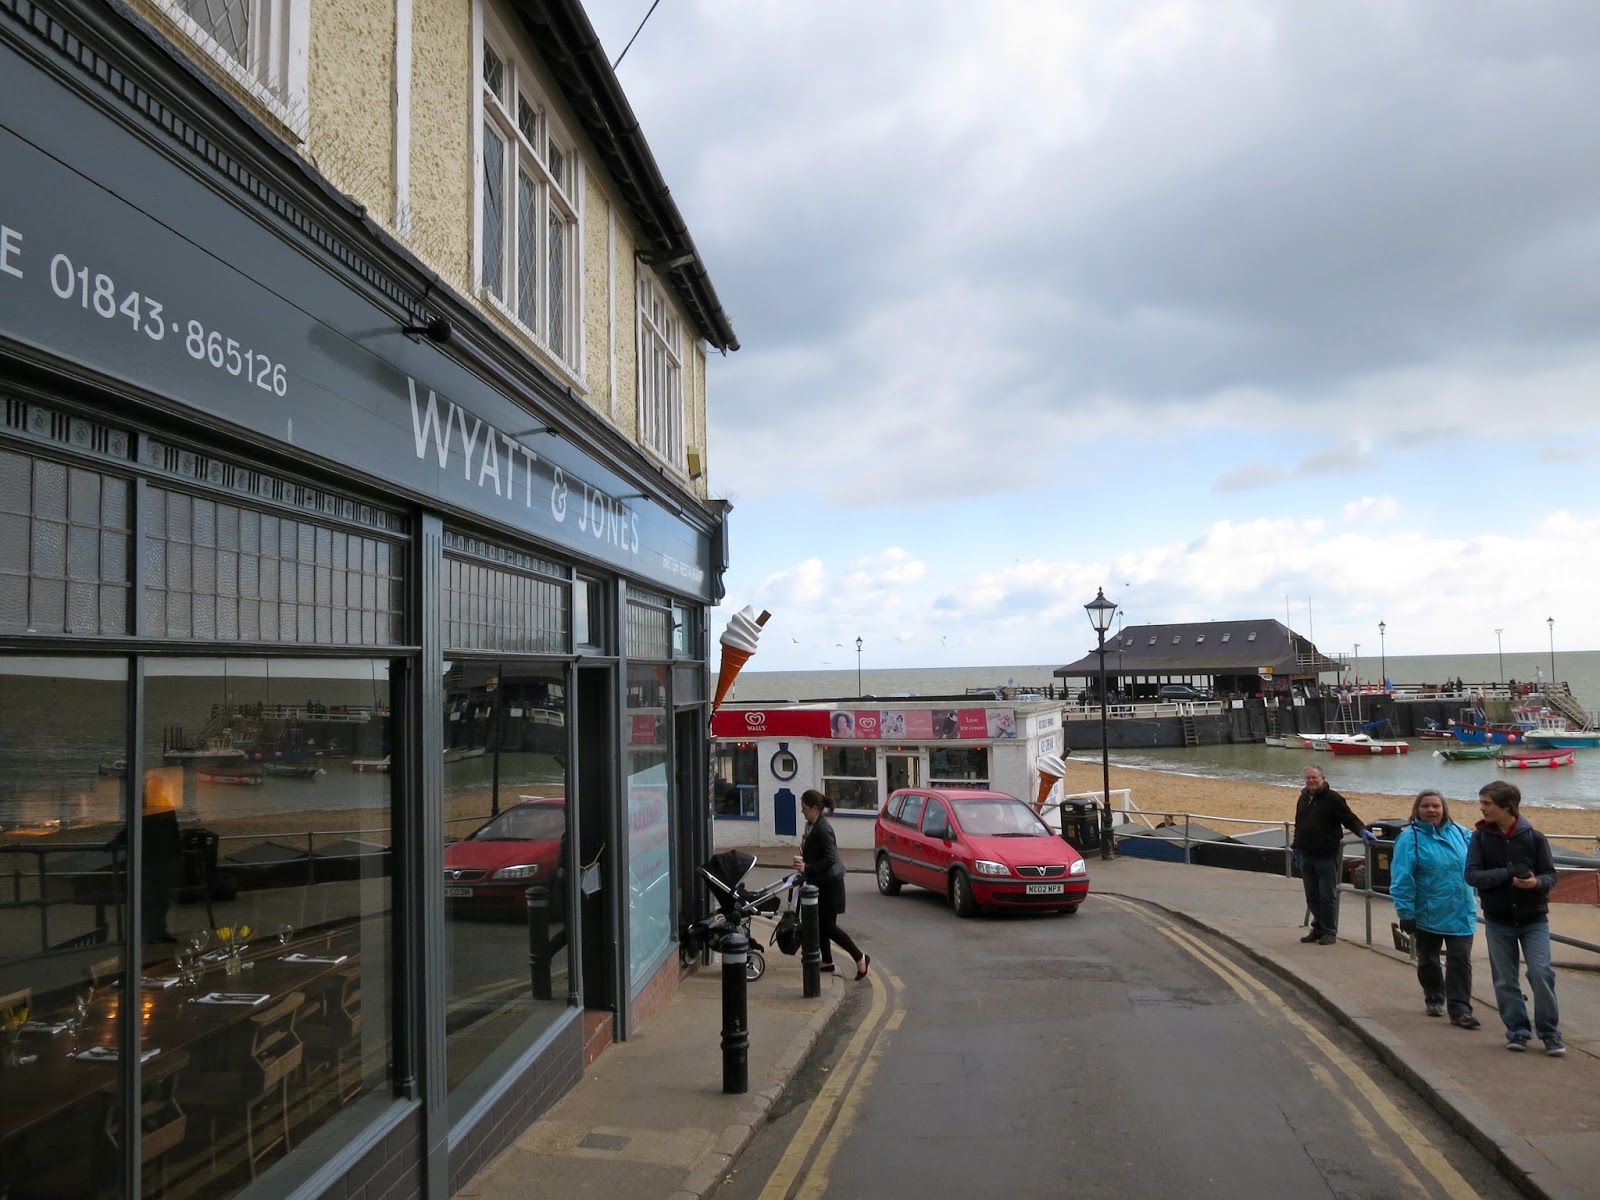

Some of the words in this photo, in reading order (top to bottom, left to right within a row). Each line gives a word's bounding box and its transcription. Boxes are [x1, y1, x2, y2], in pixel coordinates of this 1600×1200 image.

[407, 376, 537, 508] WYATT
[551, 466, 568, 522] &
[578, 482, 639, 555] JONES
[747, 724, 766, 732] WALL'S
[1028, 885, 1047, 893] NE02
[1048, 885, 1062, 893] MPX
